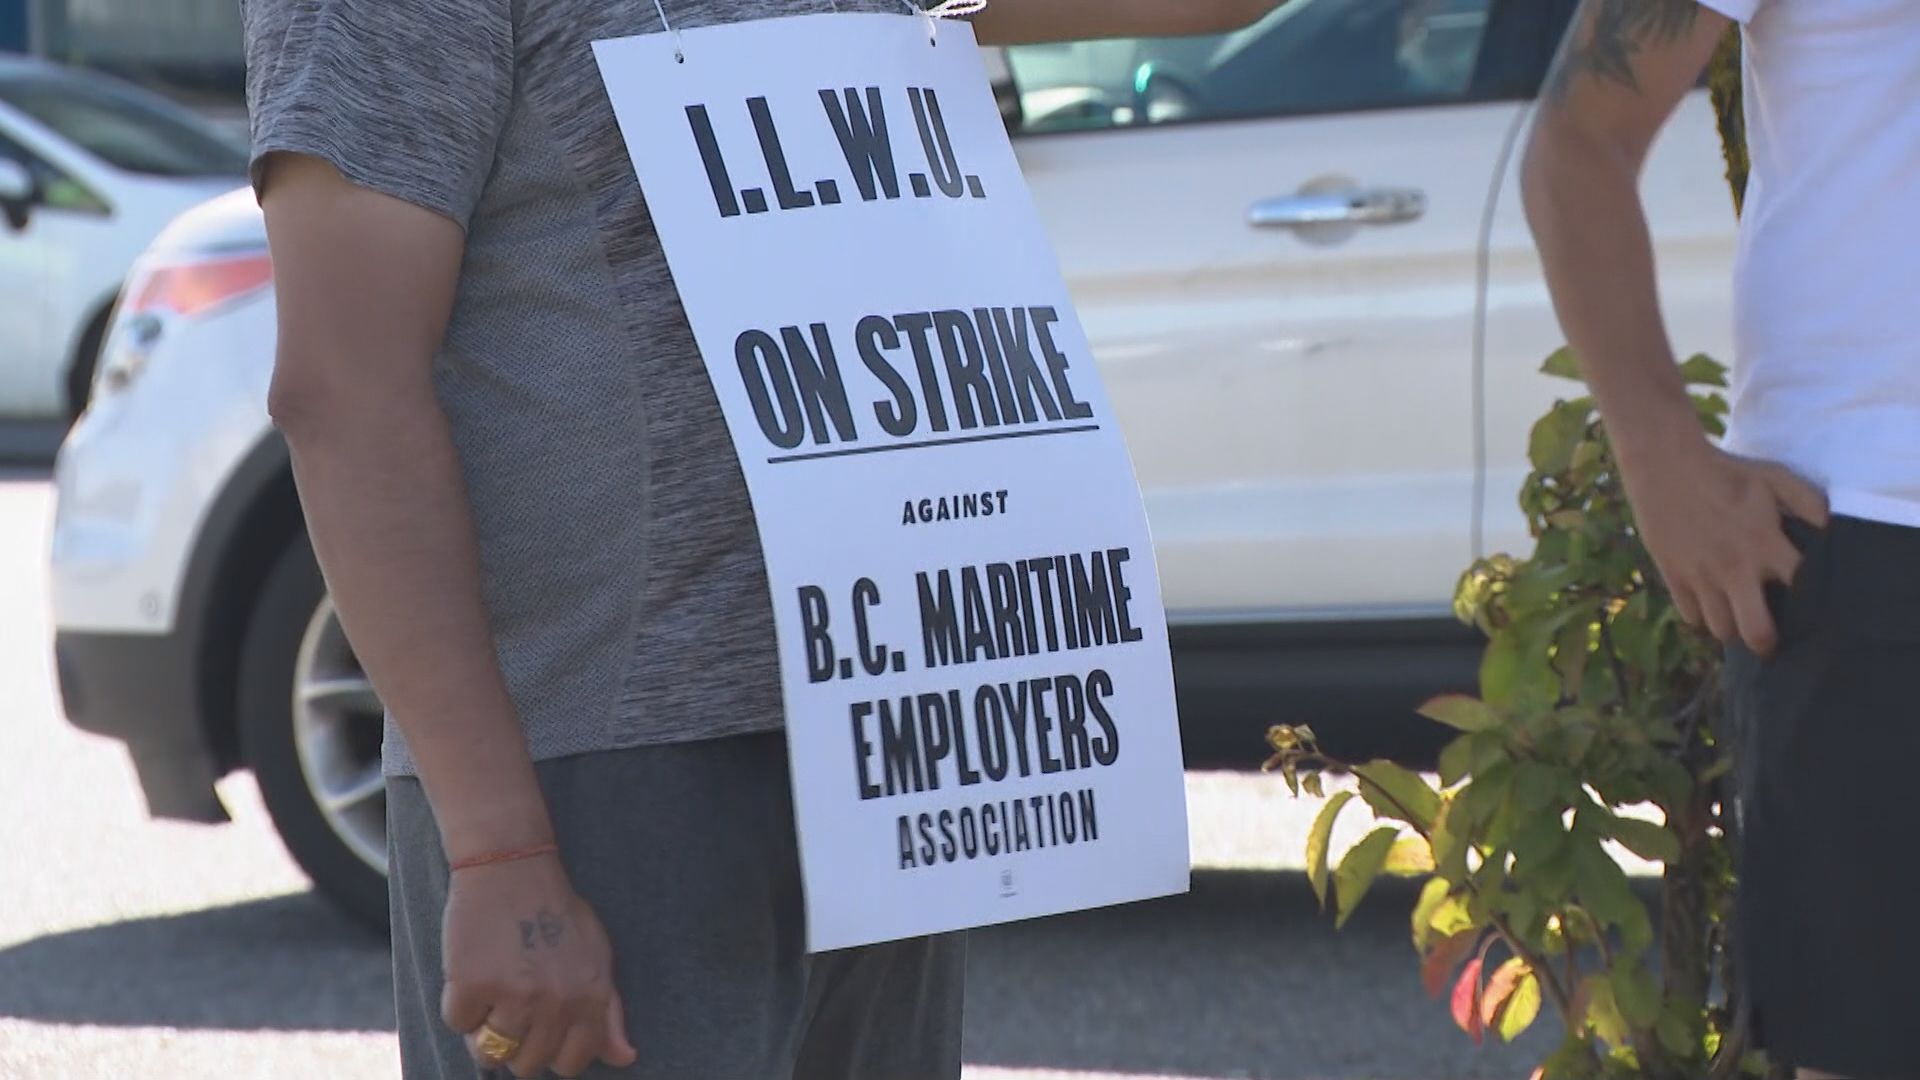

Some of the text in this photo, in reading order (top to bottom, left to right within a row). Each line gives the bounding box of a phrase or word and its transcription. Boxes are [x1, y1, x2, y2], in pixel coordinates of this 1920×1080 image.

[685, 87, 986, 218] I.L.W.U.
[735, 306, 1094, 449] ON STRIKE
[902, 489, 1009, 526] AGAINST
[797, 547, 1143, 684] B.C. MARITIME
[850, 669, 1119, 800] EMPLOYERS
[897, 788, 1099, 870] ASSOCIATION
